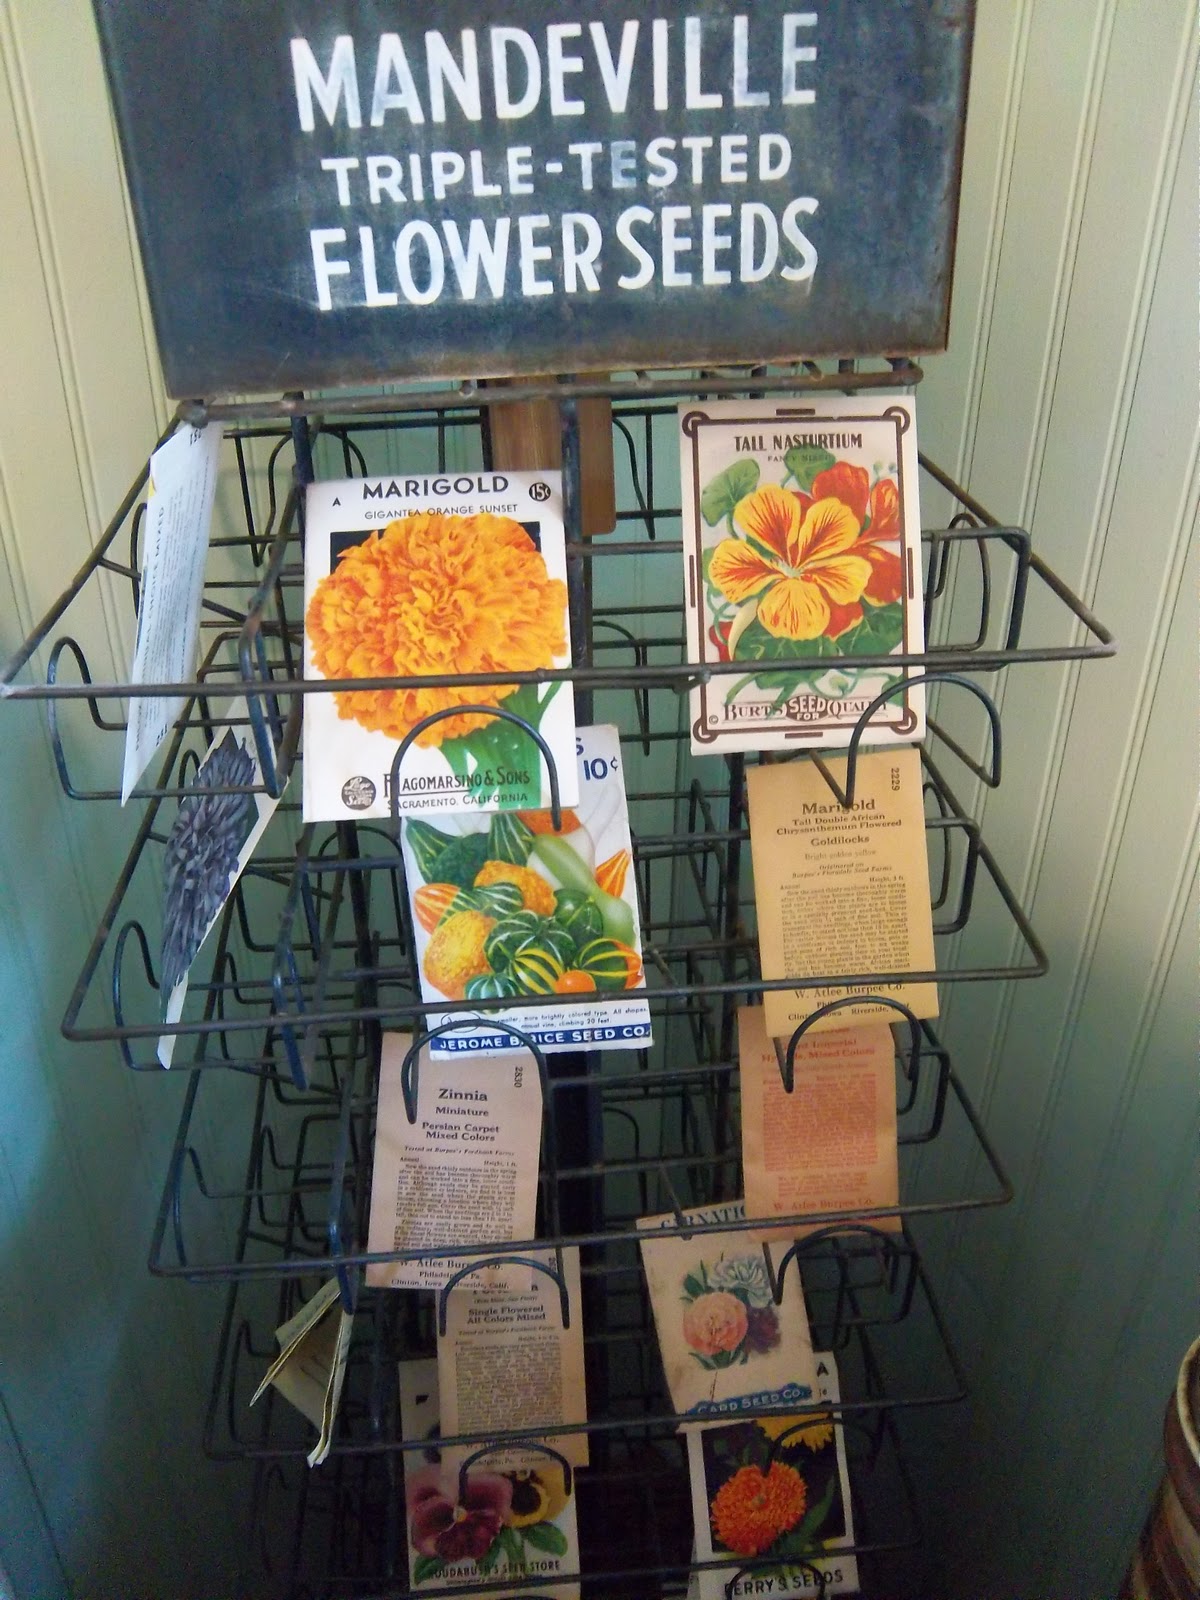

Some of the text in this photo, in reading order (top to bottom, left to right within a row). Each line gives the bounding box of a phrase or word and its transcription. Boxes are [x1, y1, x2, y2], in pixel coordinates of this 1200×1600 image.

[291, 13, 818, 131] MANDEVILLE
[321, 134, 792, 206] TRIPLE-TESTED
[310, 198, 819, 311] FLOWER SEEDS
[734, 433, 862, 452] TALL NASTURTIUM
[363, 476, 509, 500] MARIGOLD
[332, 497, 341, 507] A
[364, 504, 518, 520] GIGANTEA ORANGE SUNSET
[788, 694, 826, 712] SEED
[796, 712, 820, 721] FOR
[401, 774, 482, 792] AGOMARSINO
[484, 769, 494, 786] &
[497, 767, 530, 785] SONS
[890, 767, 900, 791] 2229
[463, 793, 528, 804] CALIFORNIA
[792, 814, 886, 827] Tall Double African
[776, 820, 902, 836] Chrysanthemum Flowered
[810, 836, 870, 846] Goldilocks
[794, 983, 905, 999] W. Atlee Burpee Co.
[440, 1038, 503, 1050] JEROME
[572, 1030, 615, 1042] SEED
[438, 1088, 488, 1102] Zinnia
[435, 1106, 489, 1117] Miniature
[422, 1122, 499, 1134] Persian Carpet
[425, 1132, 495, 1142] Mixed Colors
[417, 1258, 444, 1268] Atlee
[468, 1305, 544, 1317] Single Flowered
[467, 1316, 483, 1324] All
[816, 1362, 829, 1377] A
[530, 1560, 560, 1572] STORE
